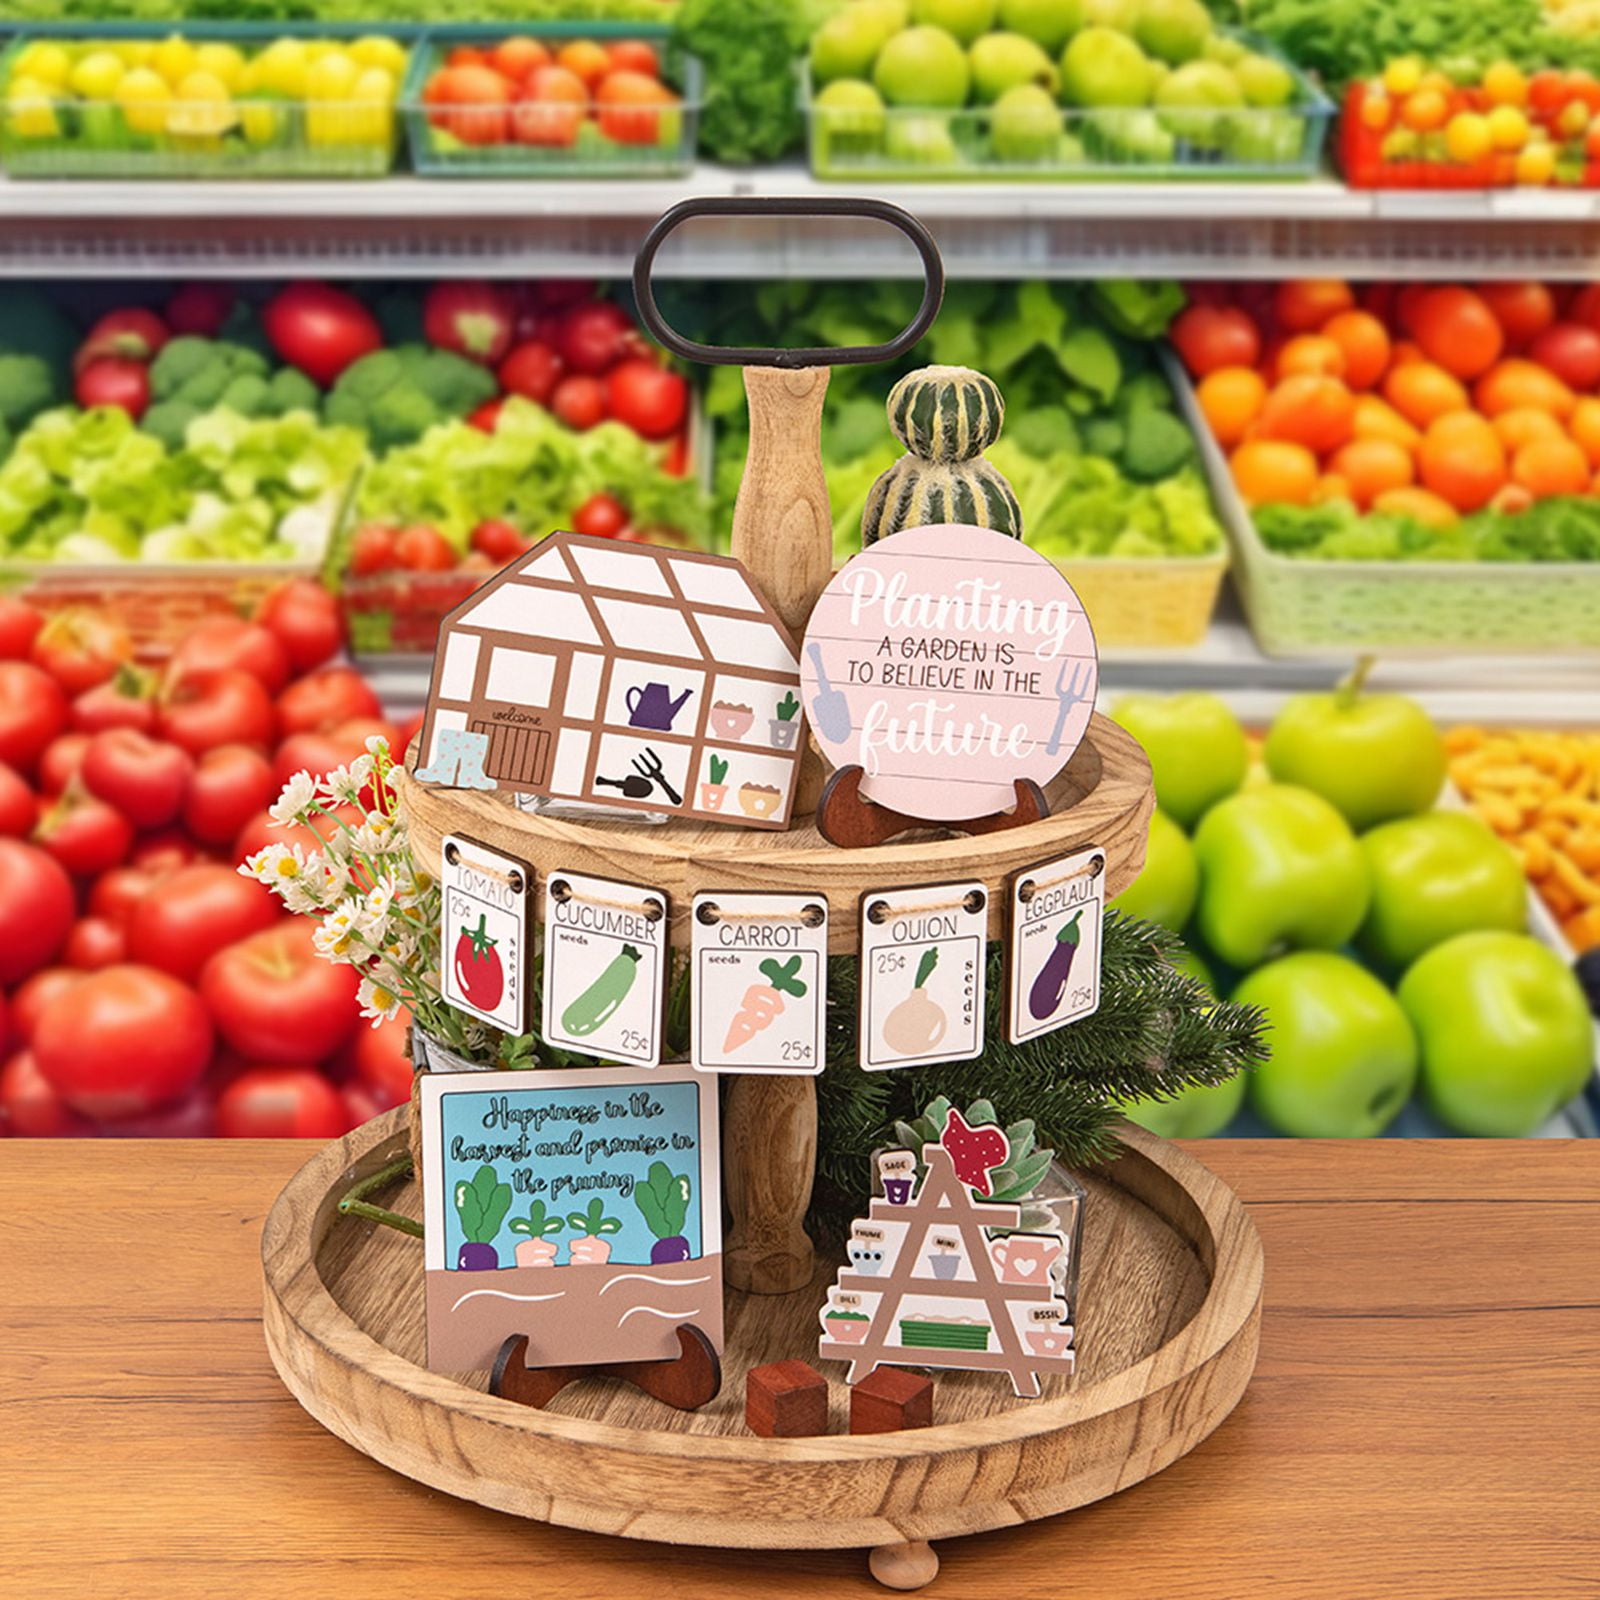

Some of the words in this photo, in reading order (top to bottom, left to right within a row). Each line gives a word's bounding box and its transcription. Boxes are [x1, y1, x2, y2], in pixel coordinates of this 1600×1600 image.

[843, 567, 1076, 660] Planting
[876, 636, 893, 657] A
[900, 637, 987, 663] GARDEN
[995, 643, 1015, 665] IS
[848, 660, 874, 684] TO
[882, 663, 965, 690] BELIEVE
[974, 670, 994, 691] IN
[1003, 669, 1041, 695] THE
[492, 706, 543, 727] welcome
[858, 699, 1036, 778] future
[455, 865, 515, 910] TOMATO
[554, 902, 657, 941] CUCUMBER
[719, 924, 803, 948] CARROT
[892, 915, 958, 943] OUION
[1024, 924, 1048, 938] seeds
[559, 932, 589, 946] seeds
[707, 954, 741, 965] seeds
[963, 959, 973, 1026] seeds
[482, 1096, 601, 1132] Happiness
[604, 1100, 628, 1118] in
[629, 1091, 665, 1118] the
[451, 1133, 532, 1163] harvest
[534, 1128, 583, 1157] and
[585, 1134, 669, 1165] promise
[671, 1132, 695, 1150] in
[511, 1167, 548, 1194] the
[551, 1170, 634, 1201] pruning
